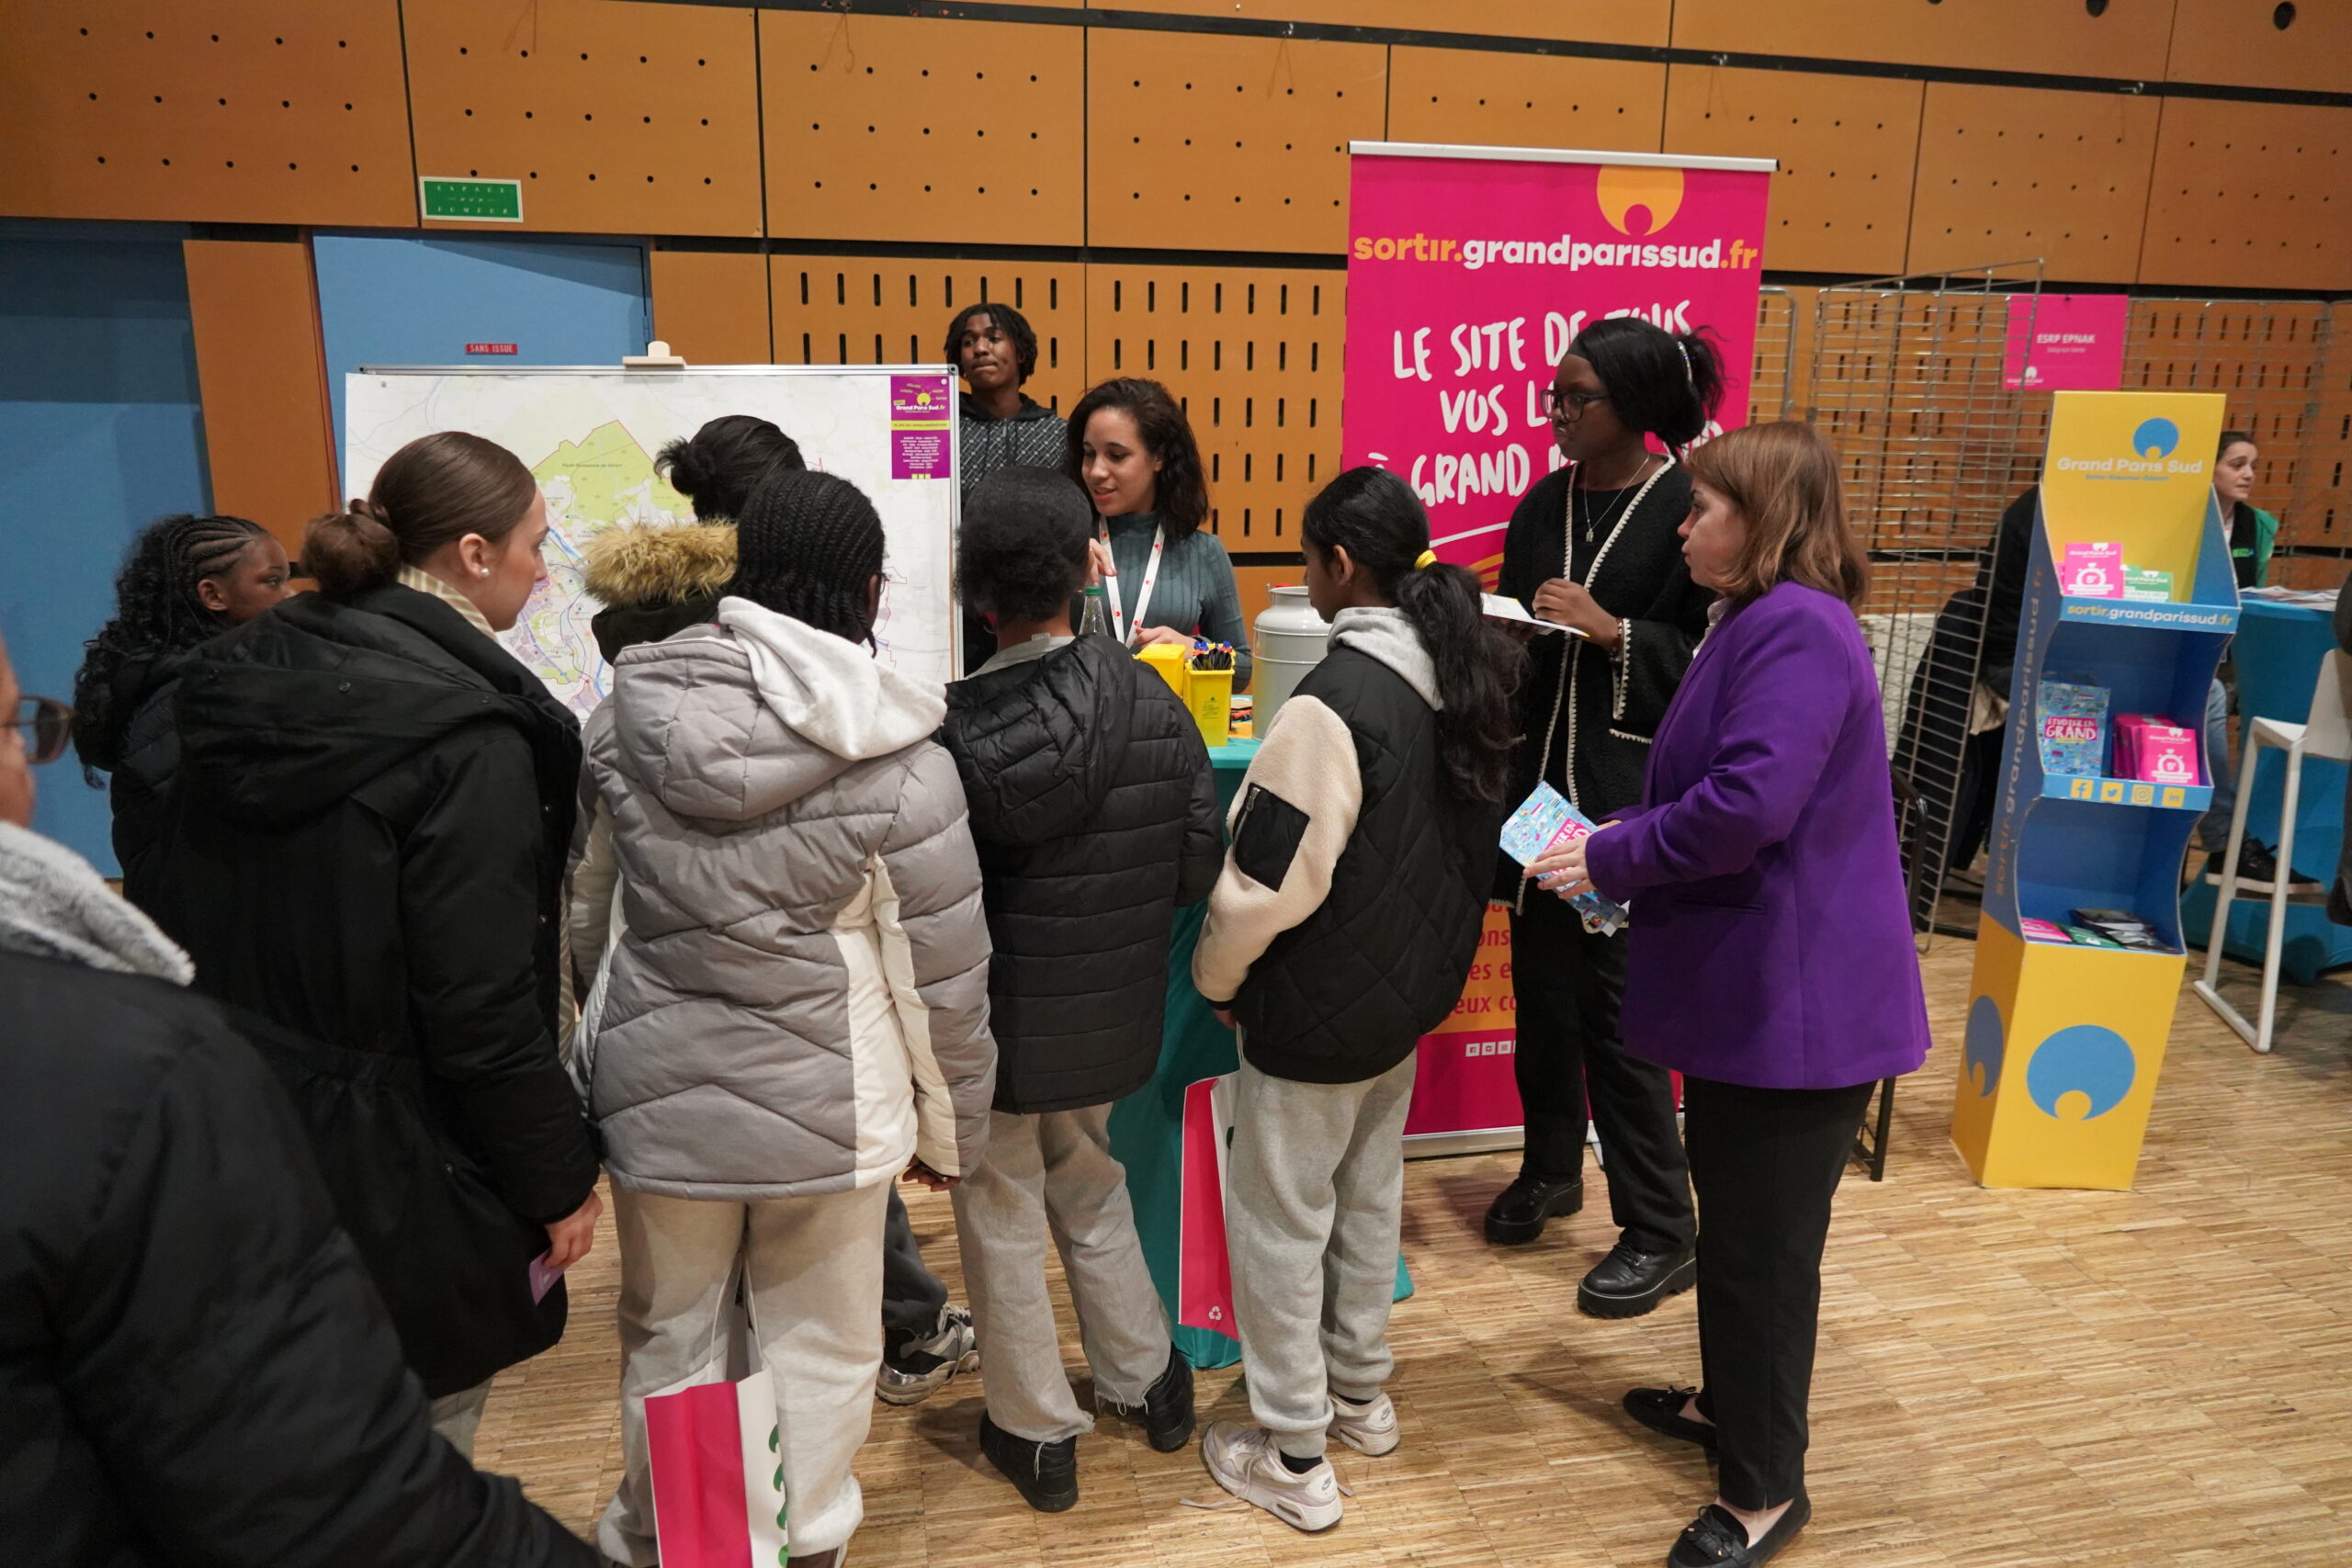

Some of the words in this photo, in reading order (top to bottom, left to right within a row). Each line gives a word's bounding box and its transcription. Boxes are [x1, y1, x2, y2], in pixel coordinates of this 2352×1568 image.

[1353, 233, 1758, 272] sortir.grandparissud.fr
[469, 344, 490, 354] SANS
[492, 344, 514, 354] ISSUE
[1394, 326, 1432, 382] LE
[1451, 317, 1527, 378] SITE
[1440, 383, 1509, 436] VOS
[1410, 444, 1531, 507] GRAND
[2057, 457, 2113, 471] Grand
[2117, 458, 2163, 473] Paris
[2167, 459, 2203, 473] Sud
[2067, 604, 2233, 626] sortir.grandparissud.fr
[2046, 725, 2097, 740] GRAND
